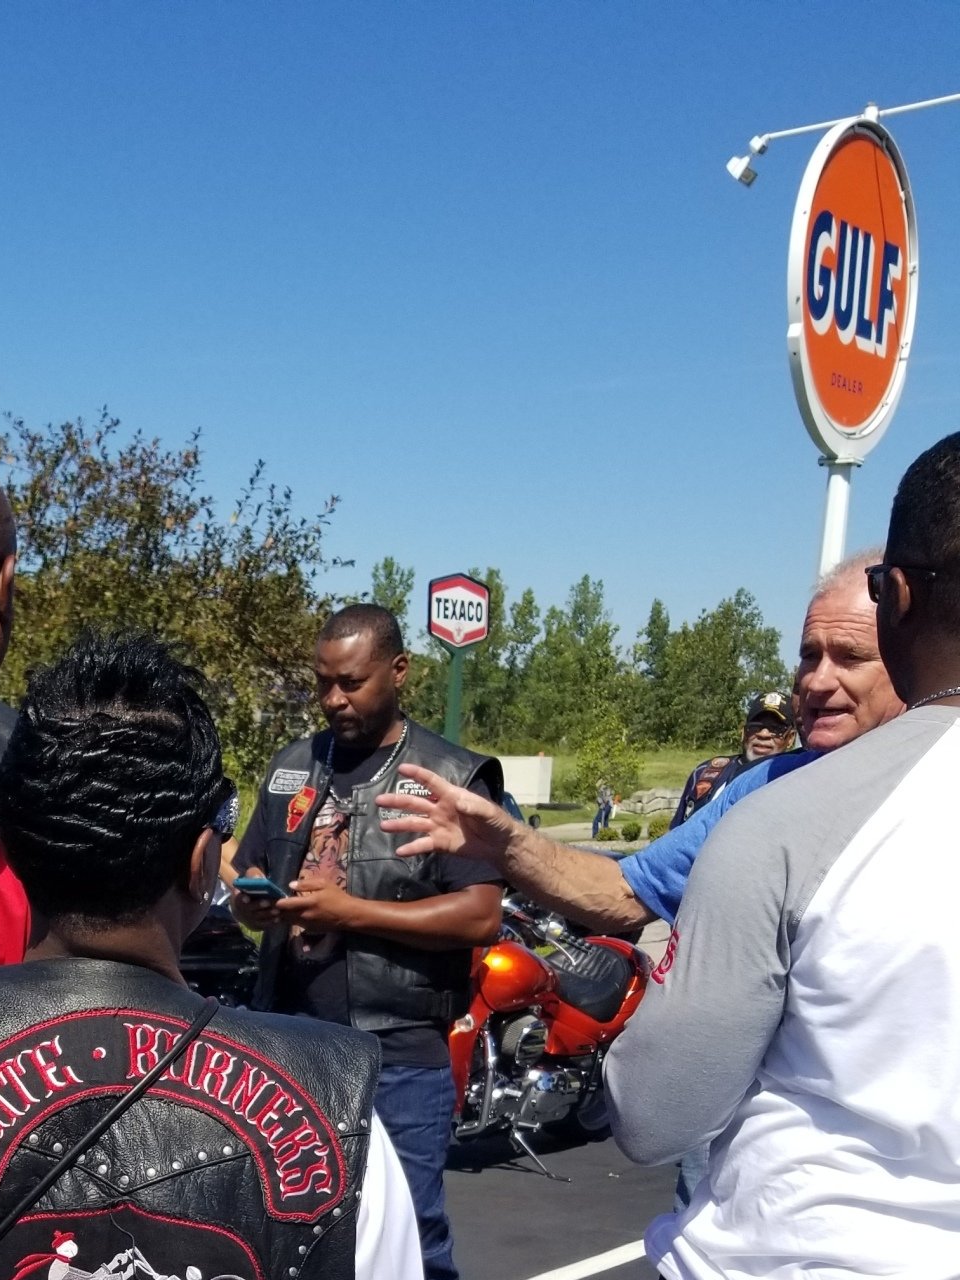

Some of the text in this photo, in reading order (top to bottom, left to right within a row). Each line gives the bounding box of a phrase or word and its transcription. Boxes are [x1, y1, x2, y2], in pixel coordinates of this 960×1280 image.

[806, 210, 902, 359] GULF
[830, 372, 865, 394] DEALER
[435, 597, 483, 623] TEXACO
